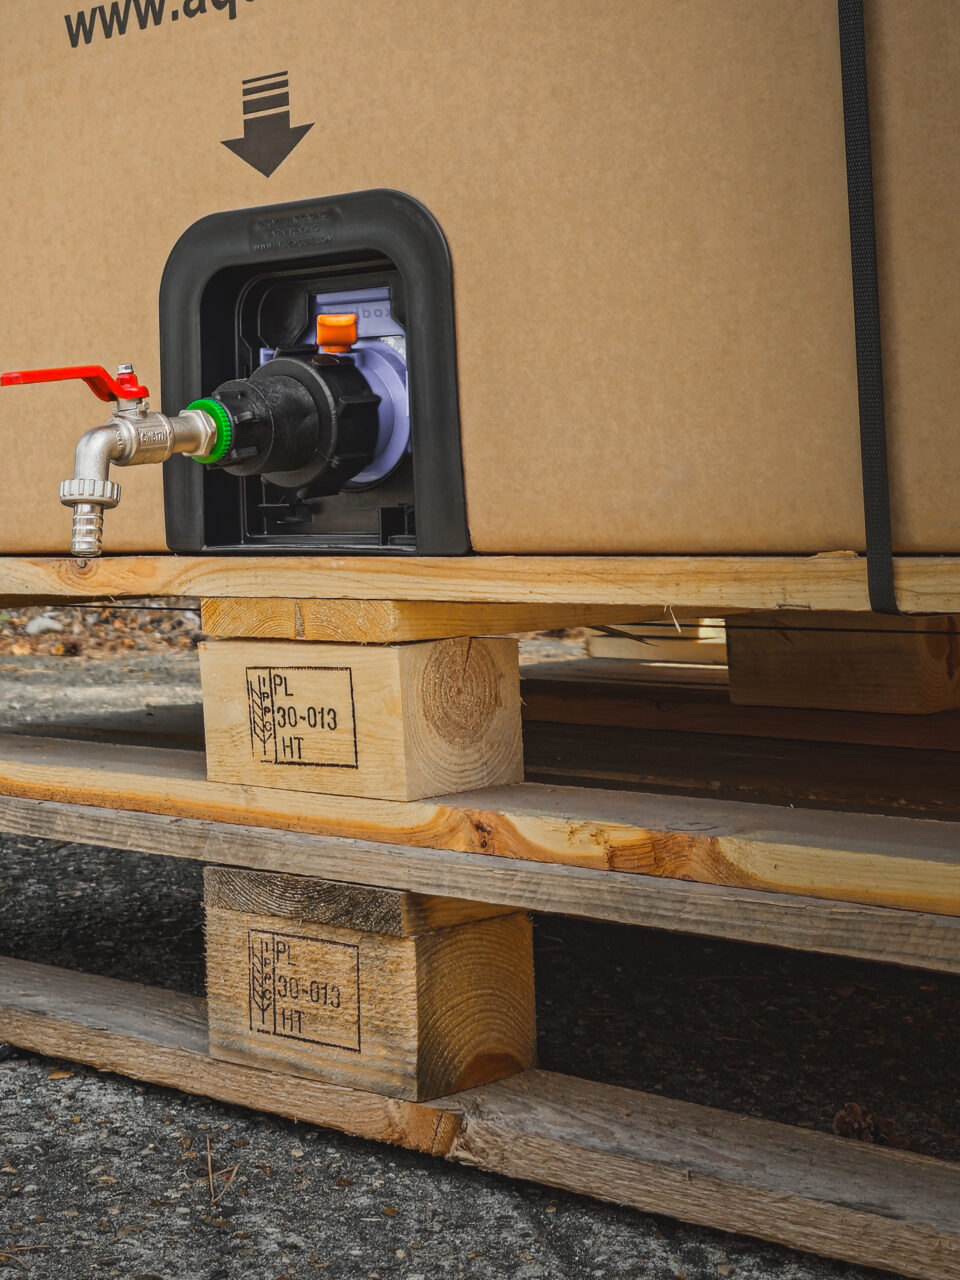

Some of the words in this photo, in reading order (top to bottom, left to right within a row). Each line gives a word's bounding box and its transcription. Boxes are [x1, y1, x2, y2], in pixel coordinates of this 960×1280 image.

[273, 674, 294, 697] PL
[276, 706, 337, 730] 30-013
[282, 736, 304, 760] HT
[278, 975, 341, 1009] 30-013
[282, 1007, 305, 1034] HT
